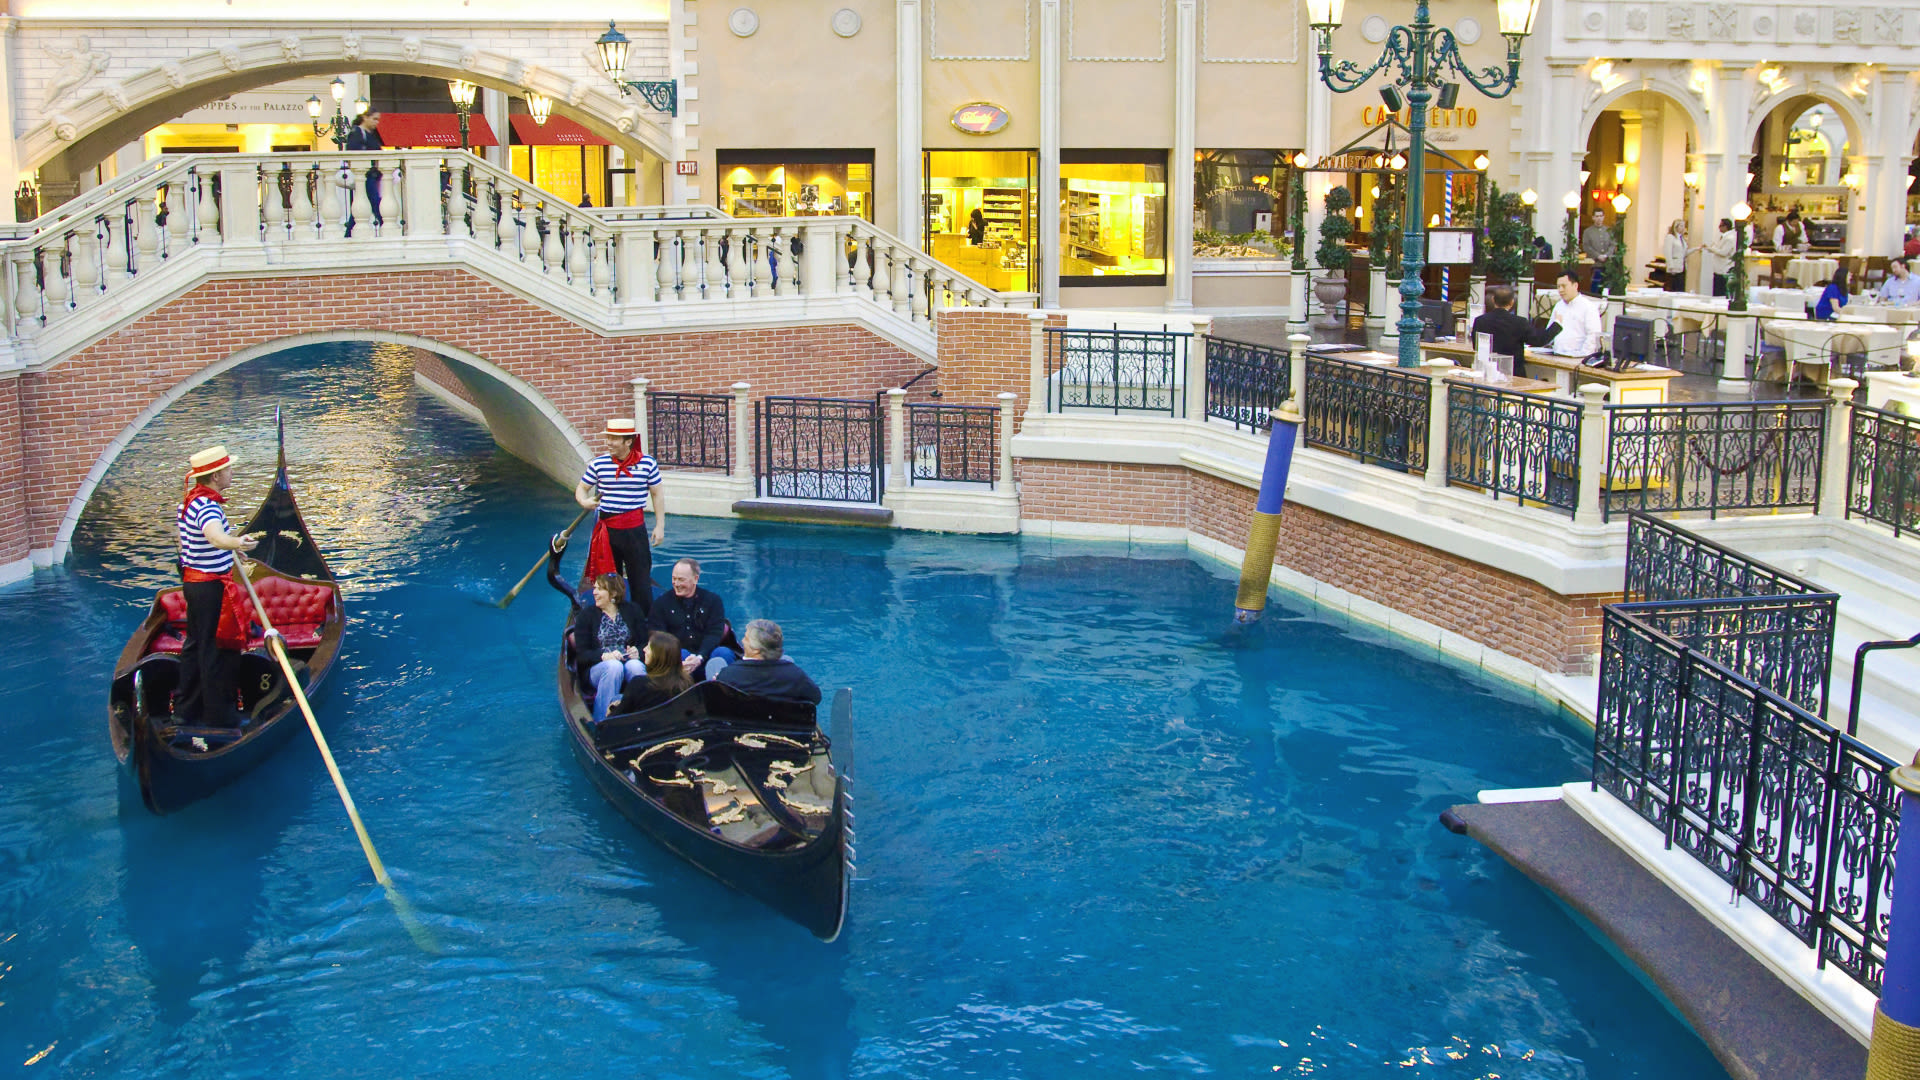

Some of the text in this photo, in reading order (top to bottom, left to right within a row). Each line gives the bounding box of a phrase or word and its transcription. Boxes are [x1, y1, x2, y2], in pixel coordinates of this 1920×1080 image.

[200, 101, 238, 111] OPPES
[263, 102, 304, 111] PALAZZO
[1362, 105, 1478, 128] CAETTO
[680, 162, 696, 174] EXIT
[260, 673, 272, 690] 8
